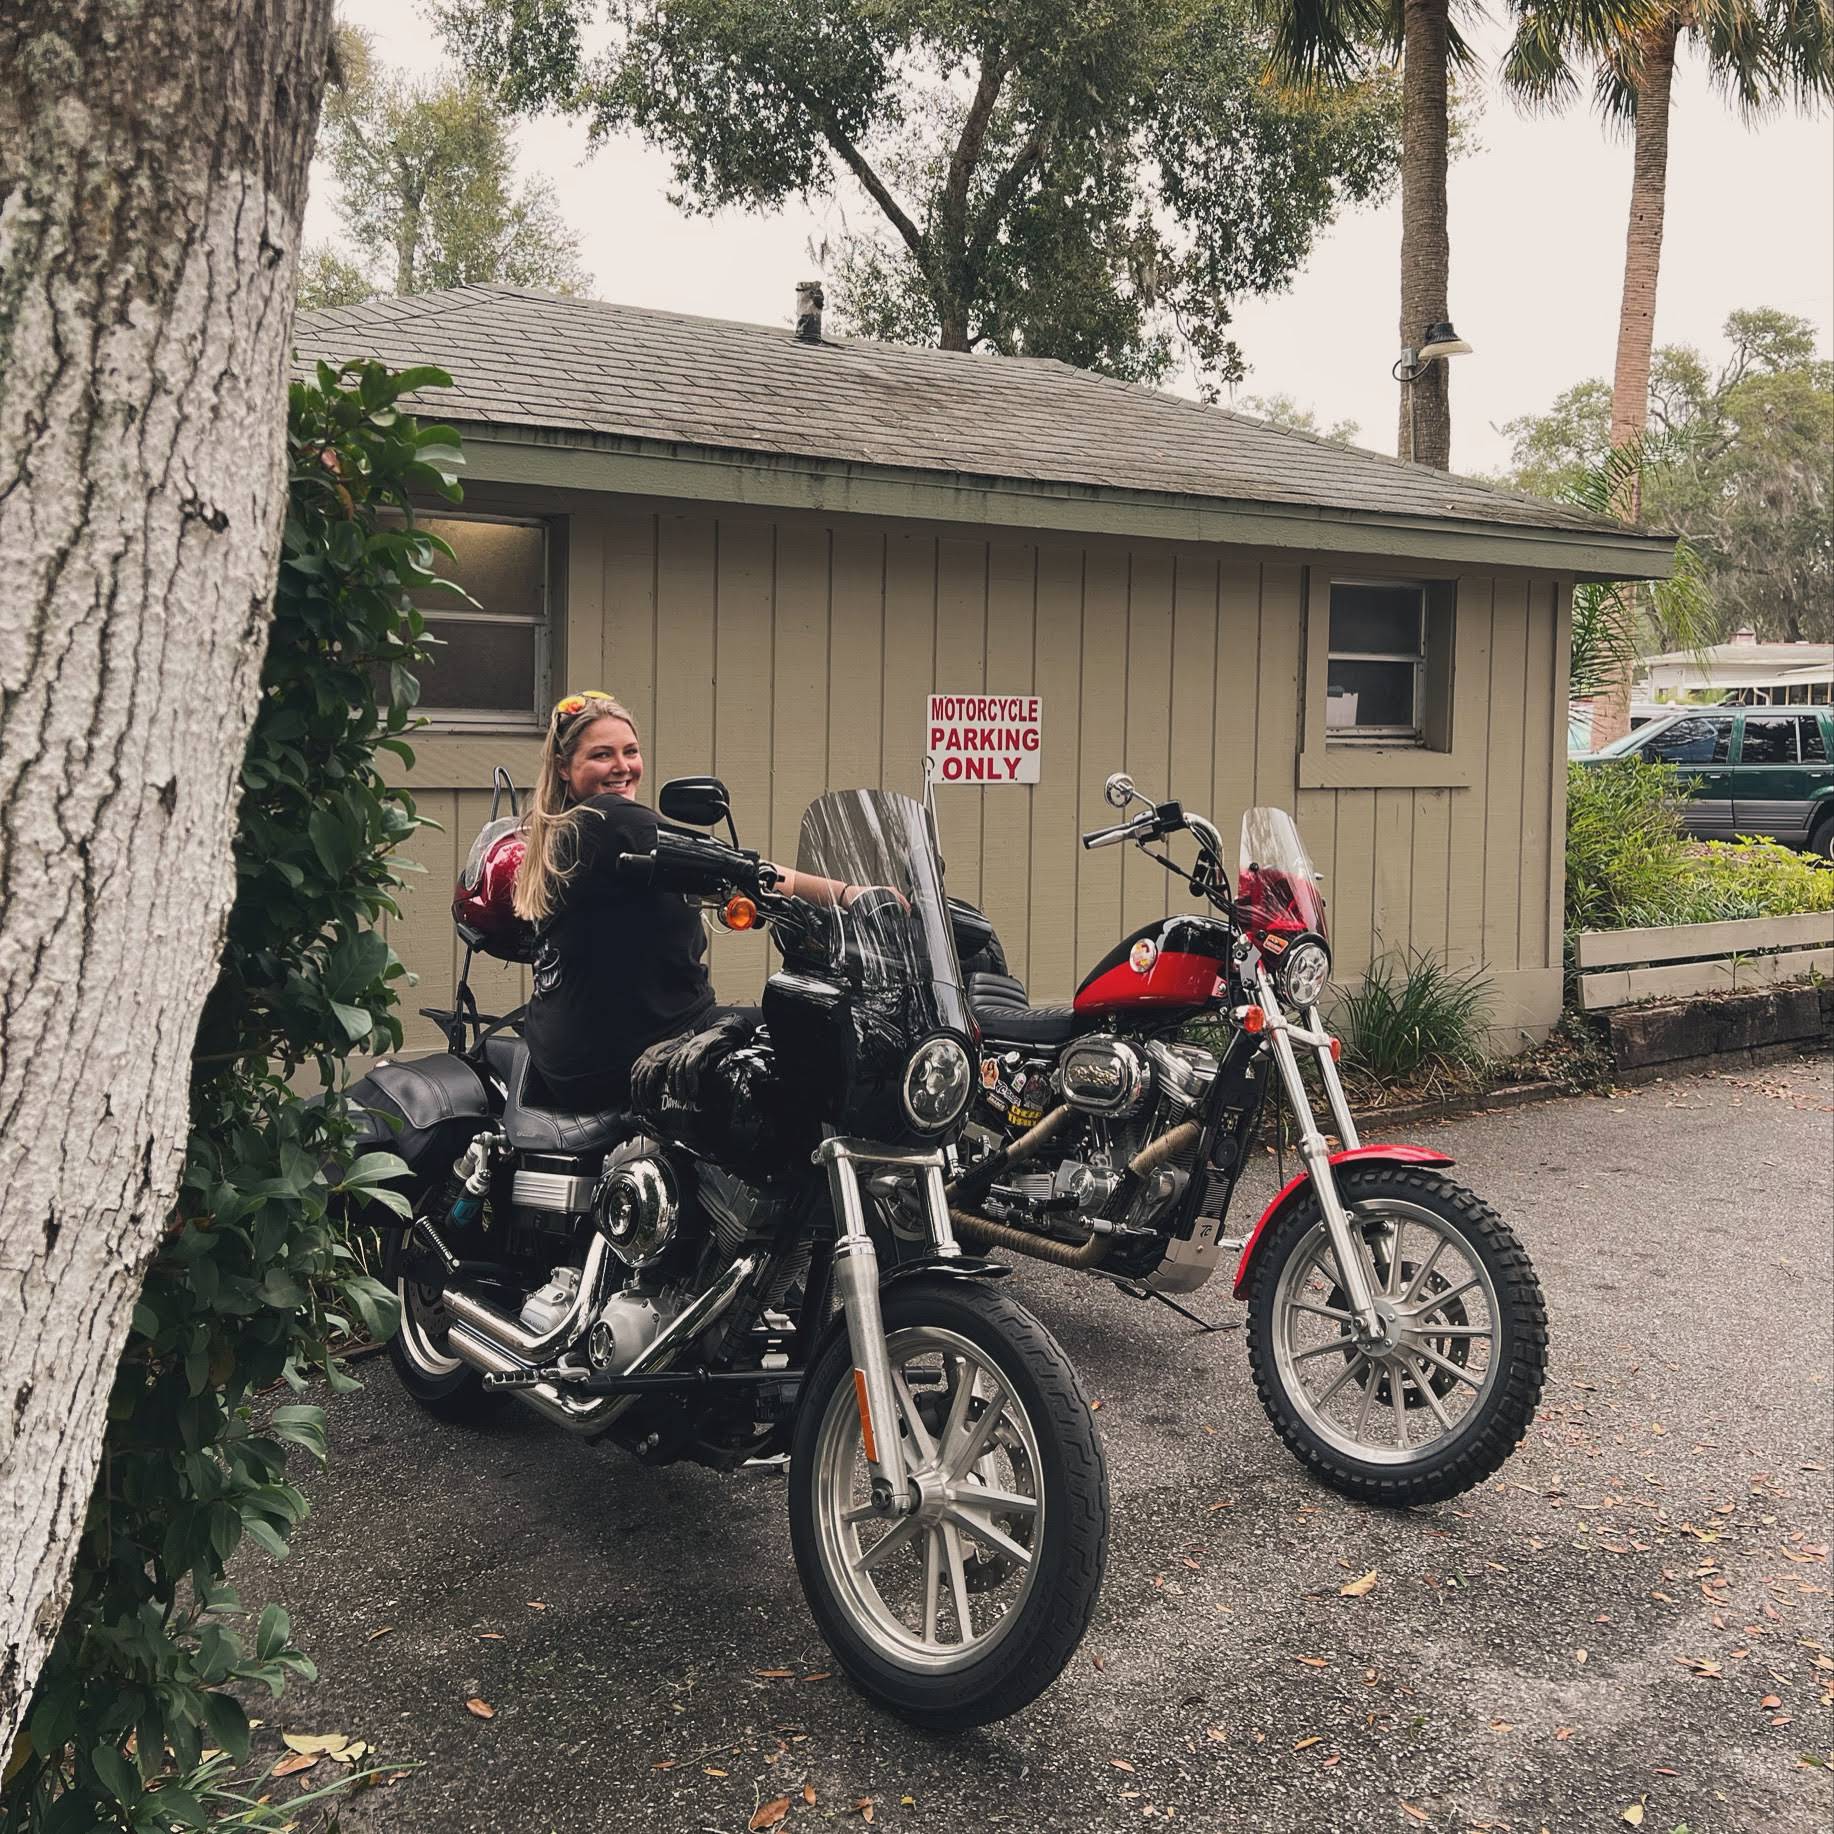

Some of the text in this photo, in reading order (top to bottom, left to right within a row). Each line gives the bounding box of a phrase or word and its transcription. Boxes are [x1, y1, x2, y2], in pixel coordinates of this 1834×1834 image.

[932, 698, 1038, 722] MOTORCYCLE
[931, 728, 1039, 751] PARKING
[943, 757, 1022, 780] ONLY
